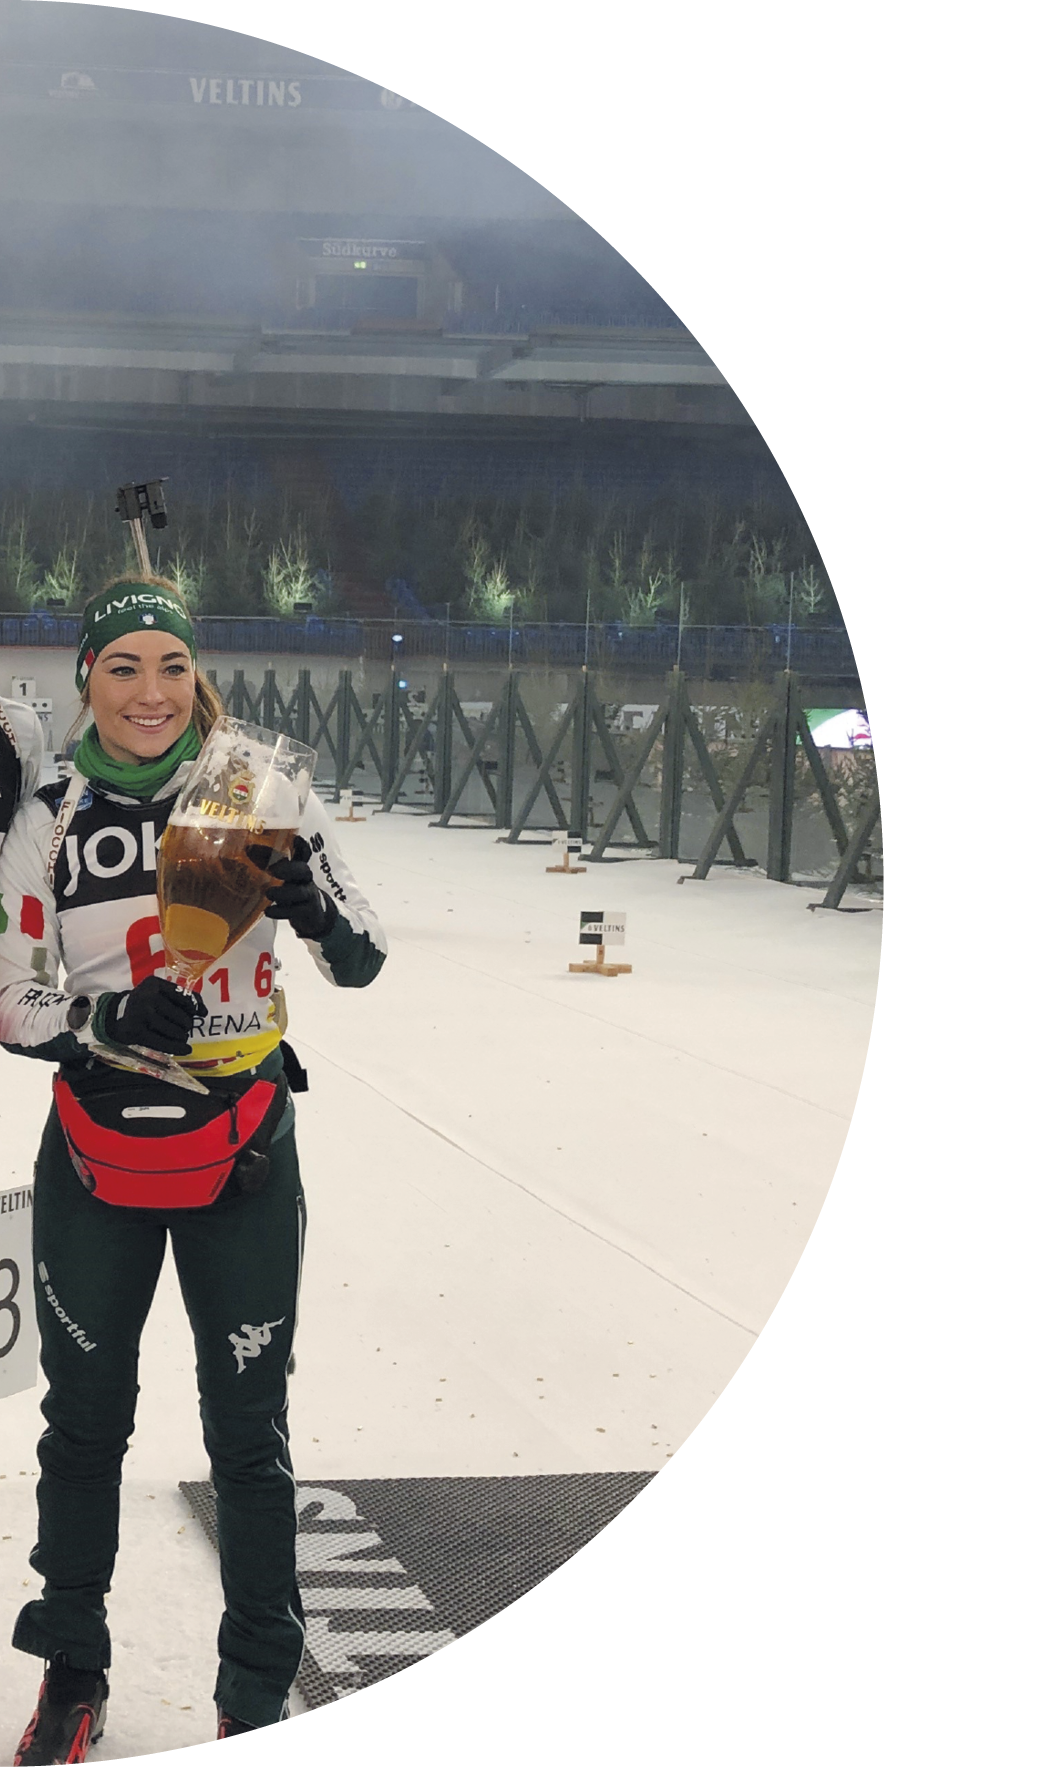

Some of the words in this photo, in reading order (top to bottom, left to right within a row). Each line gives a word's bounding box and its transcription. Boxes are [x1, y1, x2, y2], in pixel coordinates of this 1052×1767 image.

[189, 78, 302, 107] VELTINS
[94, 594, 187, 622] LIVIGNO
[19, 682, 27, 696] 1
[48, 801, 71, 885] FIOCCHI
[63, 821, 164, 897] JOK
[593, 924, 625, 933] VELTINS
[190, 1011, 261, 1038] RENA
[47, 1284, 97, 1352] sportful
